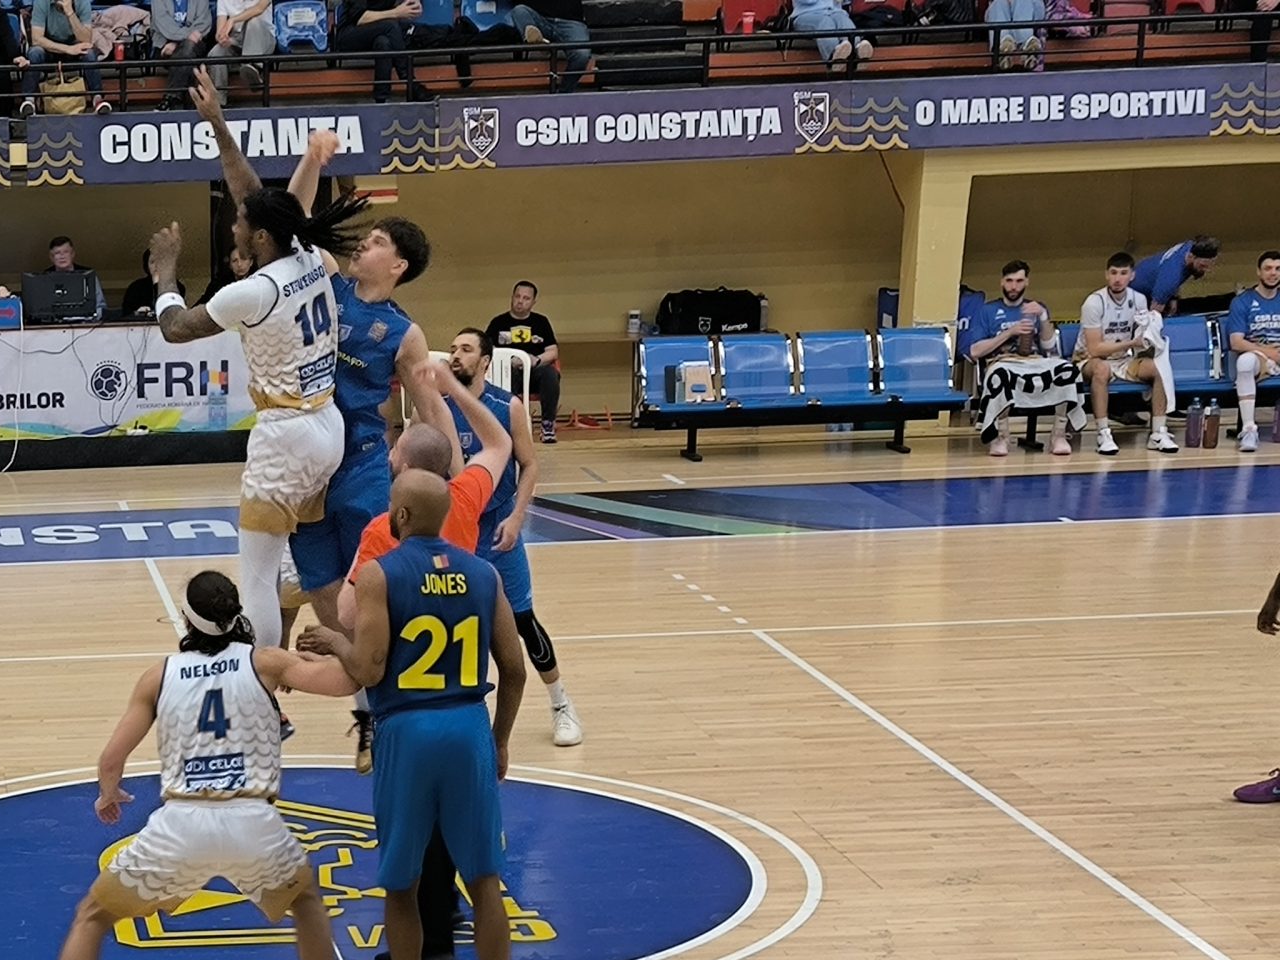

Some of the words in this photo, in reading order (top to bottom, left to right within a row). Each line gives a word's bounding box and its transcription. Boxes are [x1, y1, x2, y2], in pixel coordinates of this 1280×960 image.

[516, 115, 589, 146] CSM
[594, 107, 782, 143] CONSTANȚA
[915, 99, 935, 126] O
[941, 96, 1024, 125] MARE
[1029, 94, 1065, 122] DE
[1070, 89, 1206, 119] SPORTIVI
[421, 573, 467, 595] JONES
[180, 658, 240, 680] NELSON
[398, 614, 480, 690] 21
[197, 687, 231, 740] 4
